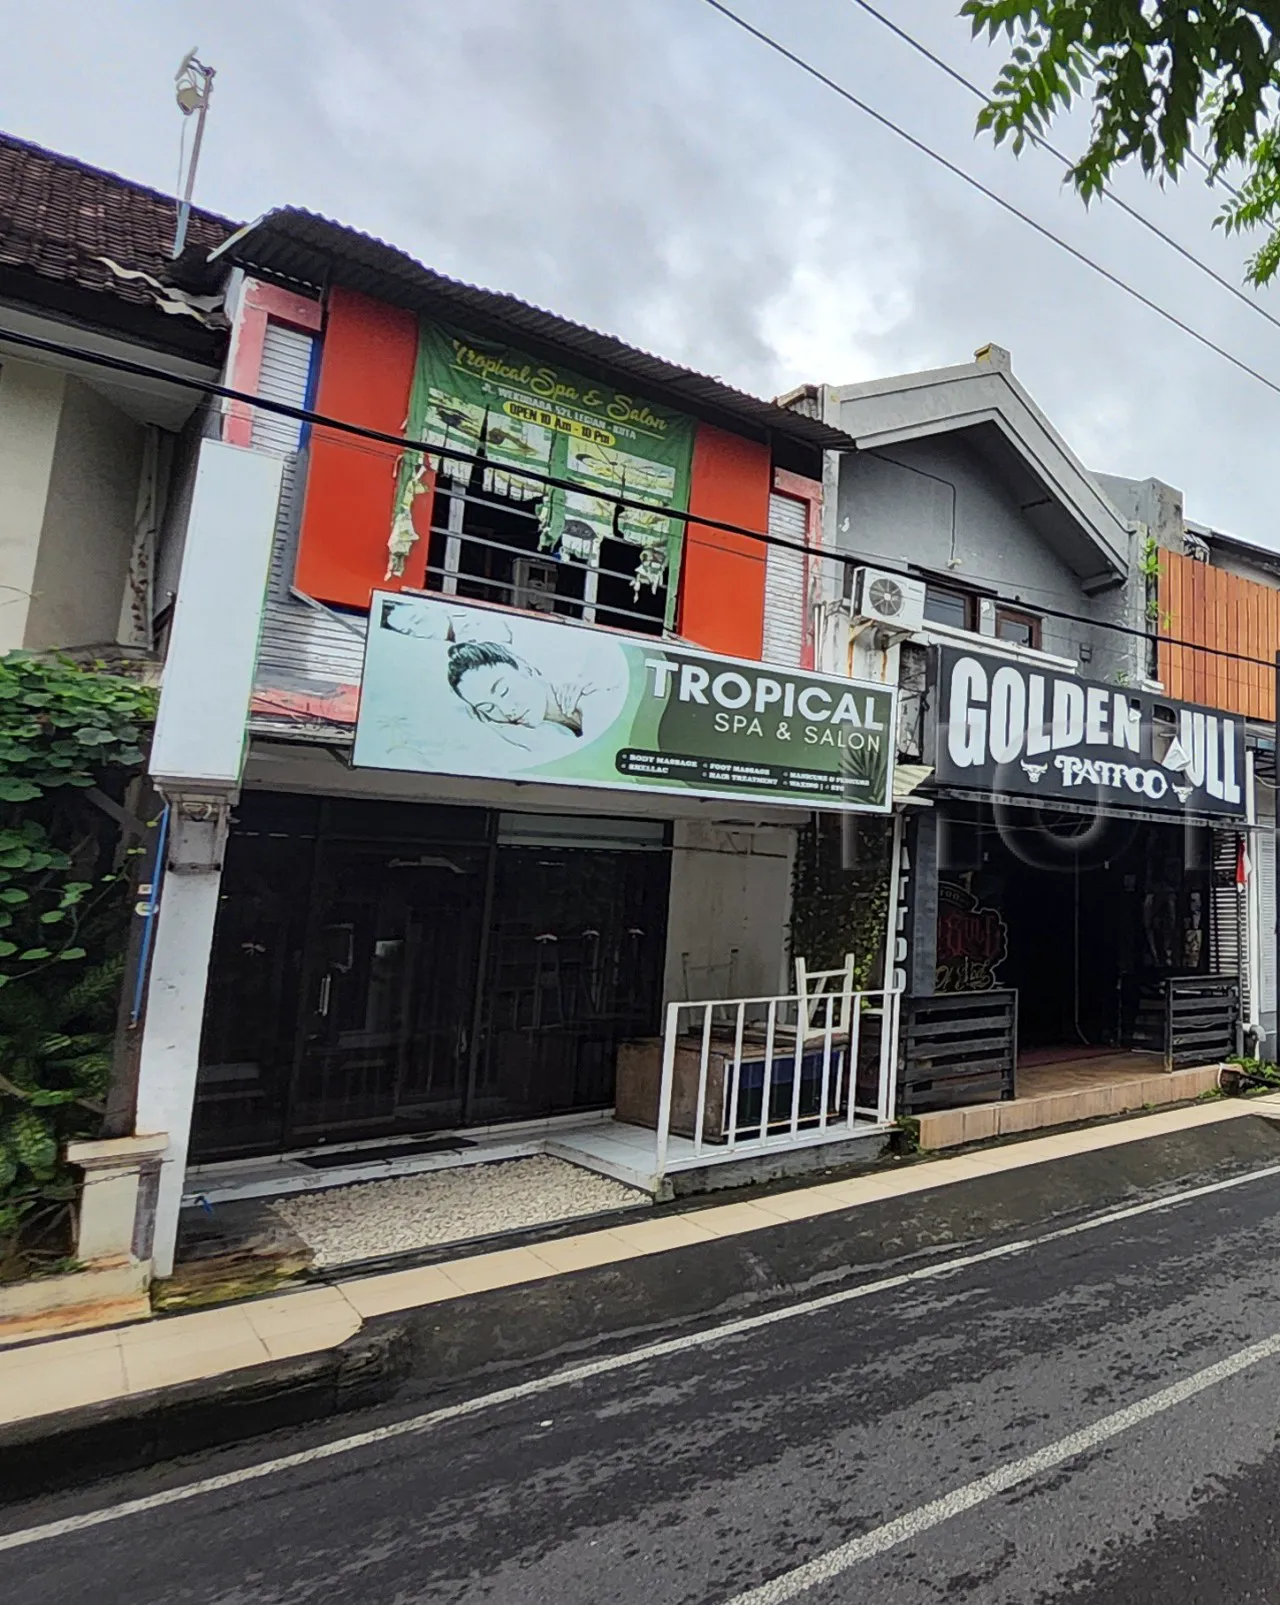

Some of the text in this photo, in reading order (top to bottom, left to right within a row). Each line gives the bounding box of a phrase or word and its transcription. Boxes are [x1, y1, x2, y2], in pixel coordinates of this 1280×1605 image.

[452, 339, 668, 431] Tropical Spa & Salon
[509, 403, 538, 421] OPEN
[540, 412, 552, 427] 10
[554, 417, 572, 433] Am
[581, 425, 592, 437] 10
[593, 429, 610, 444] Pm
[613, 425, 637, 440] KUTA
[645, 657, 883, 732] TROPICAL
[714, 712, 881, 753] SPA & SALON
[948, 657, 1241, 804] GOLDEN ULL
[629, 753, 698, 768] BODY MASSAGE
[708, 772, 778, 786] HAIR TREATMENT
[709, 762, 770, 776] FOOT MASSAGE
[1054, 754, 1169, 799] TATTOO
